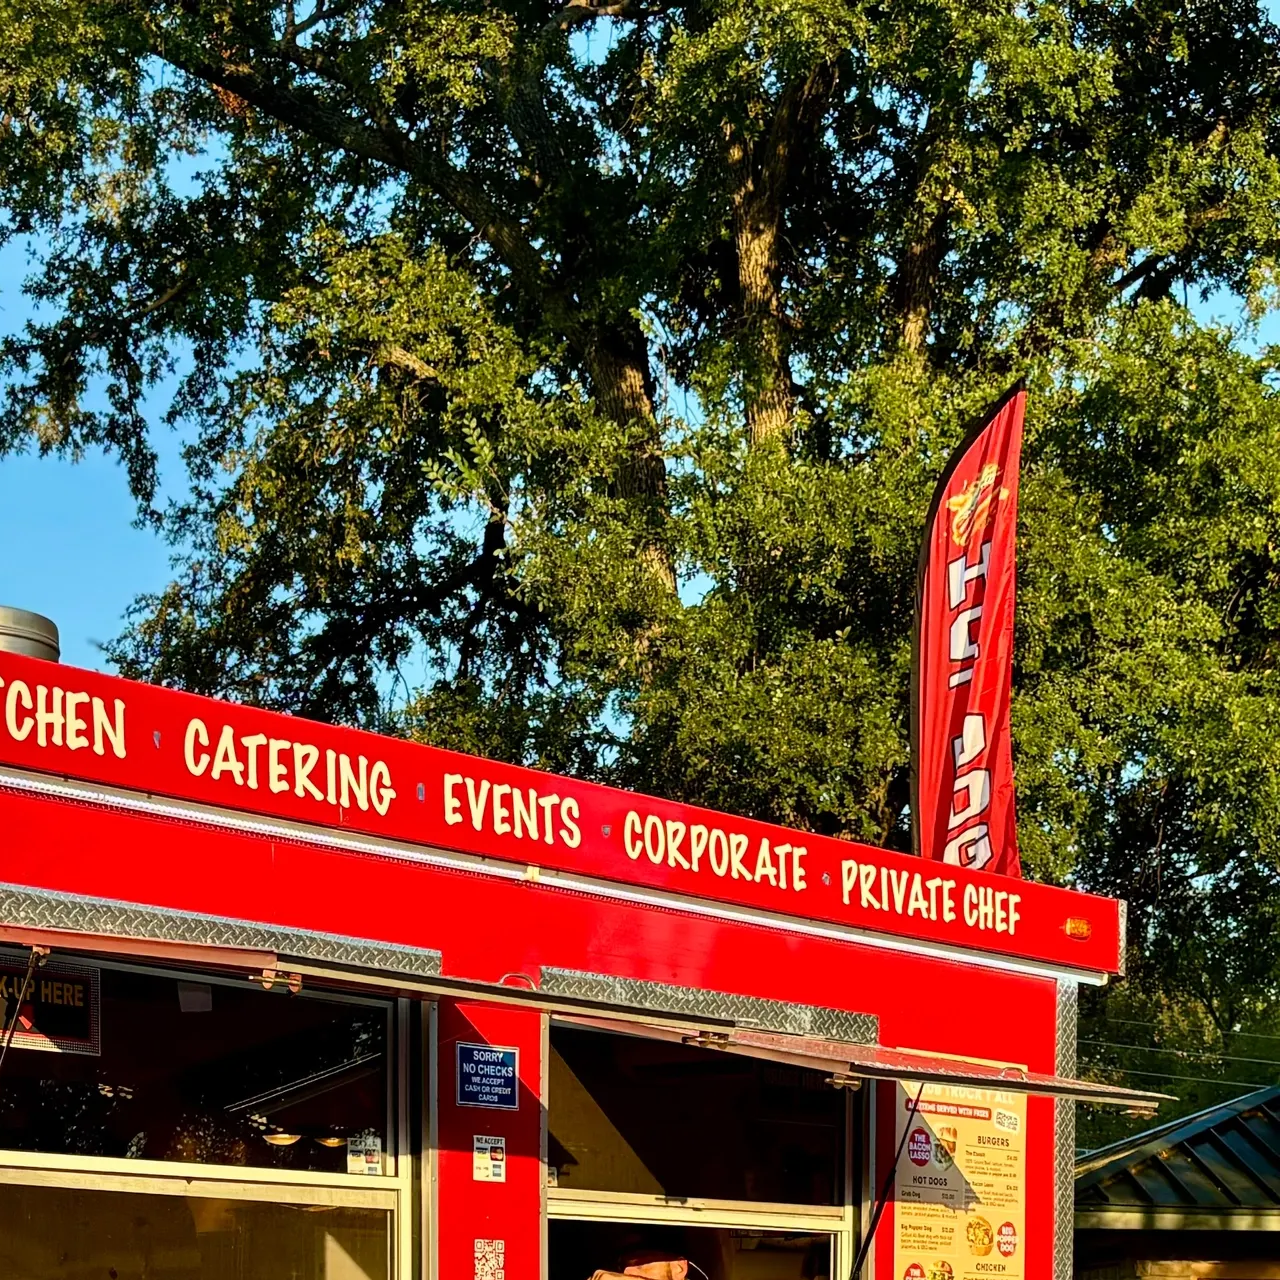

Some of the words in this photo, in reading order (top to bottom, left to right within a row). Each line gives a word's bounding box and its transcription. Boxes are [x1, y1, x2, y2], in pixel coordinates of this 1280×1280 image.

[185, 717, 395, 816] CATERING
[444, 773, 582, 849] EVENTS
[624, 810, 808, 892] CORPORATE
[841, 859, 956, 923] PRIVATE
[962, 884, 1021, 936] CHEF
[41, 980, 84, 1007] HERE
[473, 1050, 503, 1063] SORRY
[463, 1063, 476, 1074] NO
[477, 1064, 513, 1078] CHECKS
[481, 1077, 505, 1086] ACCEPT
[491, 1086, 512, 1095] CREDIT
[914, 1134, 926, 1142] THE
[977, 1136, 1010, 1147] BURGERS
[910, 1151, 930, 1159] LASSO
[913, 1176, 926, 1184] HOT
[929, 1177, 947, 1186] DOGS
[976, 1263, 1006, 1272] CHICKEN
